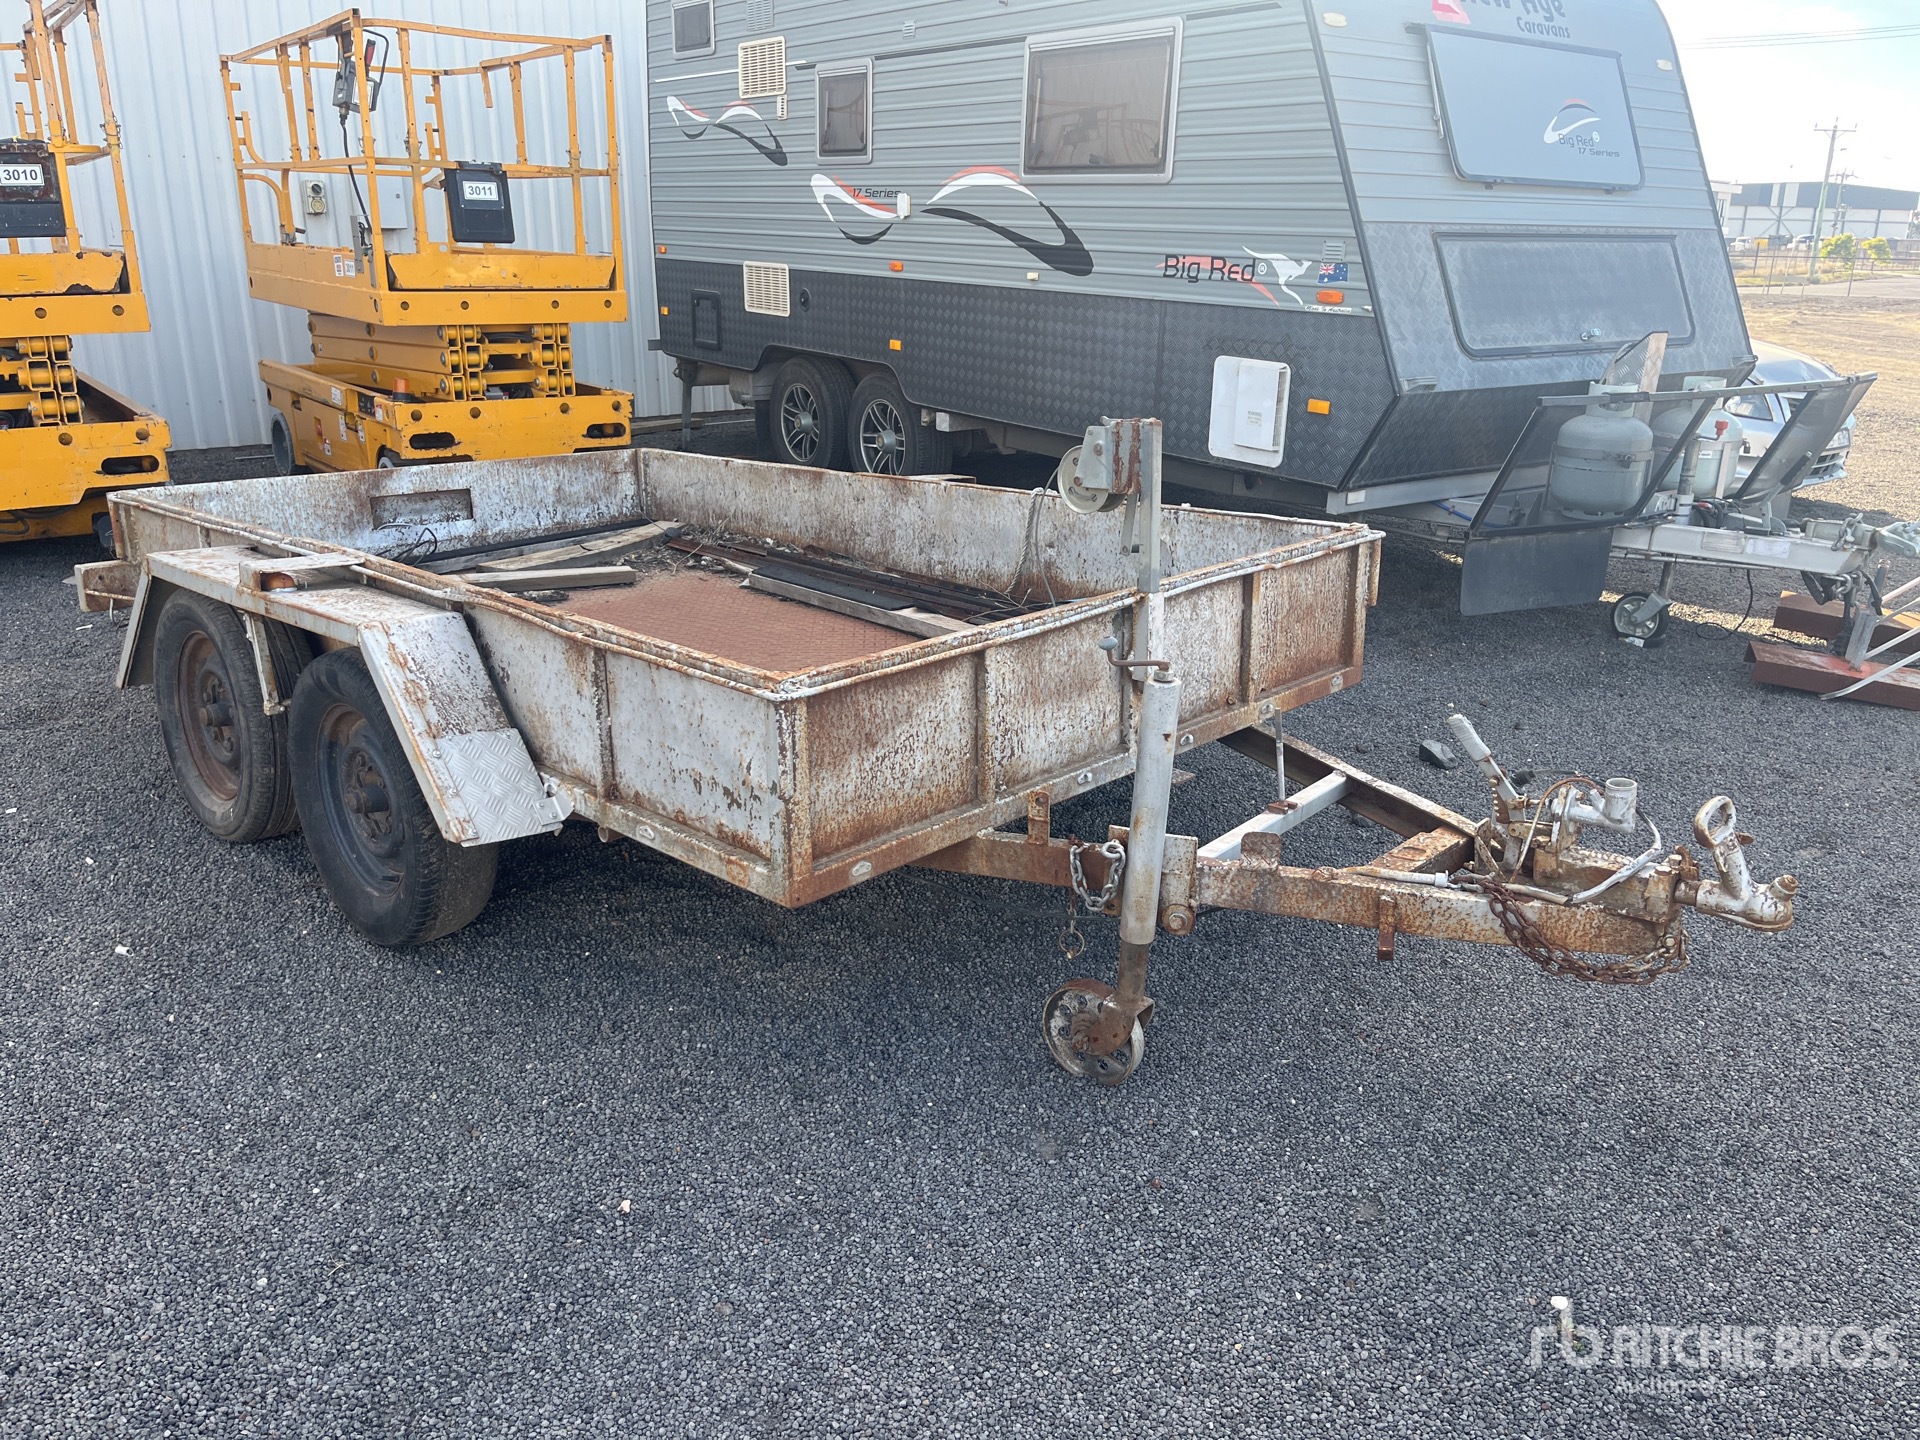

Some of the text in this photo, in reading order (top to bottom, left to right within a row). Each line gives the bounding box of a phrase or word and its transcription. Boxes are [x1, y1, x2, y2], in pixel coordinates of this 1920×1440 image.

[1516, 17, 1571, 39] Caravans
[1558, 133, 1594, 148] Big Red
[1578, 147, 1620, 158] 17 Series
[3, 169, 38, 181] 3010
[468, 186, 493, 196] 3011
[852, 188, 862, 197] 17
[1163, 254, 1256, 283] Big Red
